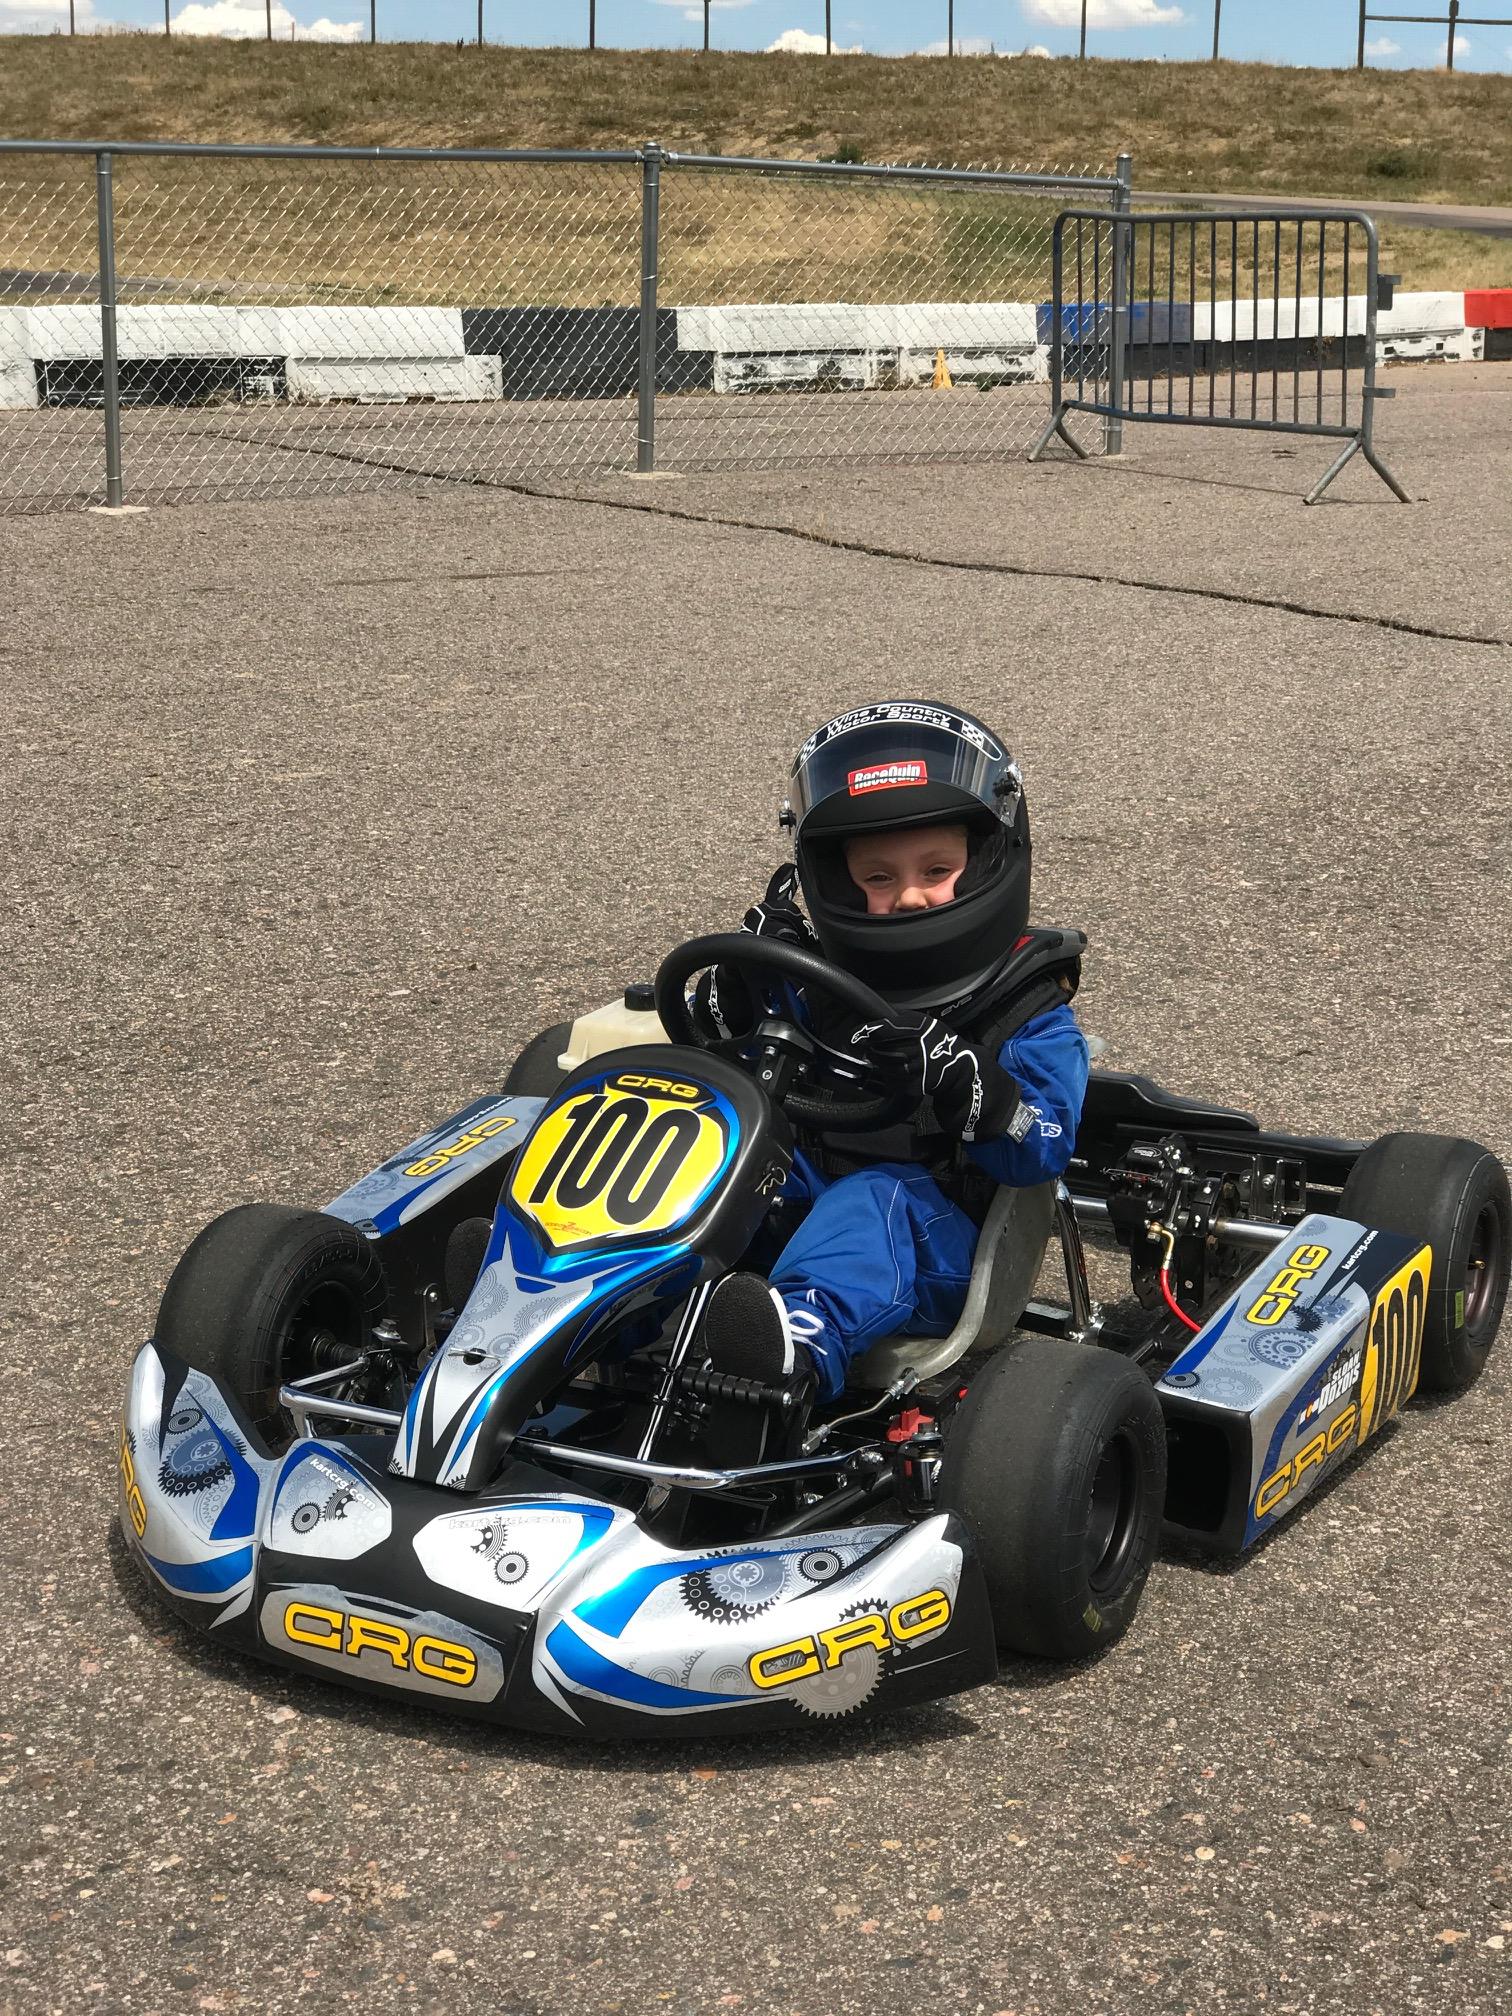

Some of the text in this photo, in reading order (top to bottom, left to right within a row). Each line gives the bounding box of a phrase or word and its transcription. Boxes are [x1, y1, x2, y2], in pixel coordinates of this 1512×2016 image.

[826, 705, 951, 730] Wine Country
[827, 712, 951, 739] Motor Sports
[616, 1074, 700, 1099] CRG
[403, 1116, 518, 1177] CRG
[528, 1094, 702, 1226] 100
[1246, 1244, 1332, 1327] CRG
[1340, 1229, 1379, 1271] kartcrg.com
[1368, 1270, 1424, 1437] 100
[309, 1457, 377, 1511] kartcrg.com
[1254, 1404, 1357, 1520] CRG
[283, 1601, 479, 1688] CRG
[748, 1590, 950, 1690] CRG
